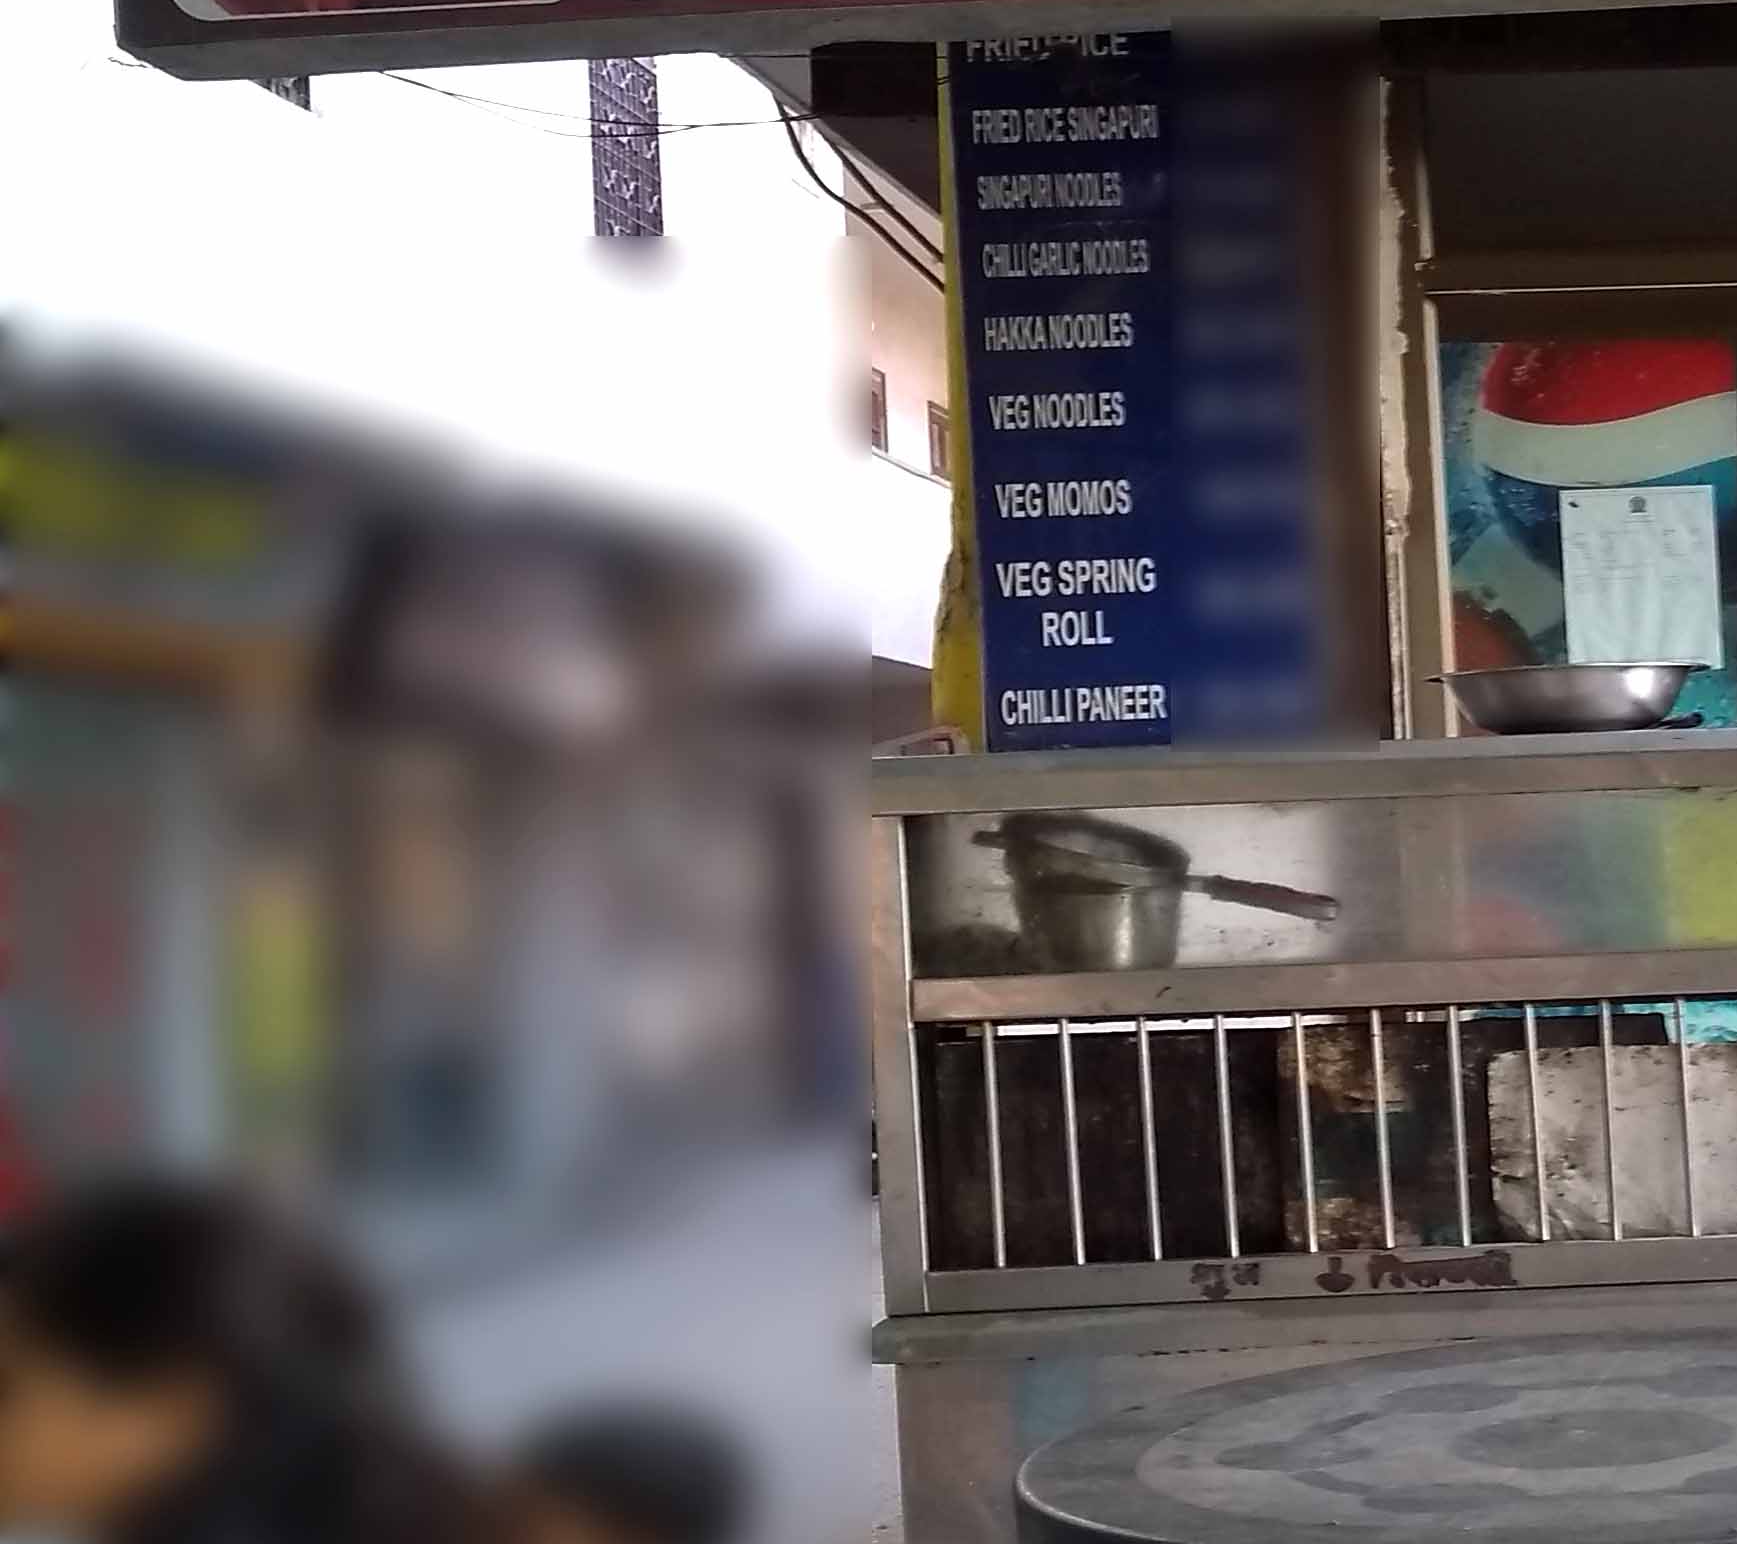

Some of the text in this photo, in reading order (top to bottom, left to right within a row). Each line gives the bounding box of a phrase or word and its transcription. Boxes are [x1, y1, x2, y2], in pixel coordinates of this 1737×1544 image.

[972, 104, 1159, 144] FRIED RICE SINGAPURI
[977, 172, 1121, 210] SINGAPURI NOODLES
[983, 239, 1149, 278] CHILLI GARLIC NOODLES
[984, 312, 1134, 351] HAKKA NOODLES
[989, 391, 1127, 430] VEG NOODLES
[995, 479, 1133, 518] VEG MOMOS
[996, 558, 1157, 597] VEG SPRING
[1041, 611, 1114, 647] ROLL
[1001, 684, 1168, 725] CHILLI PANEER
